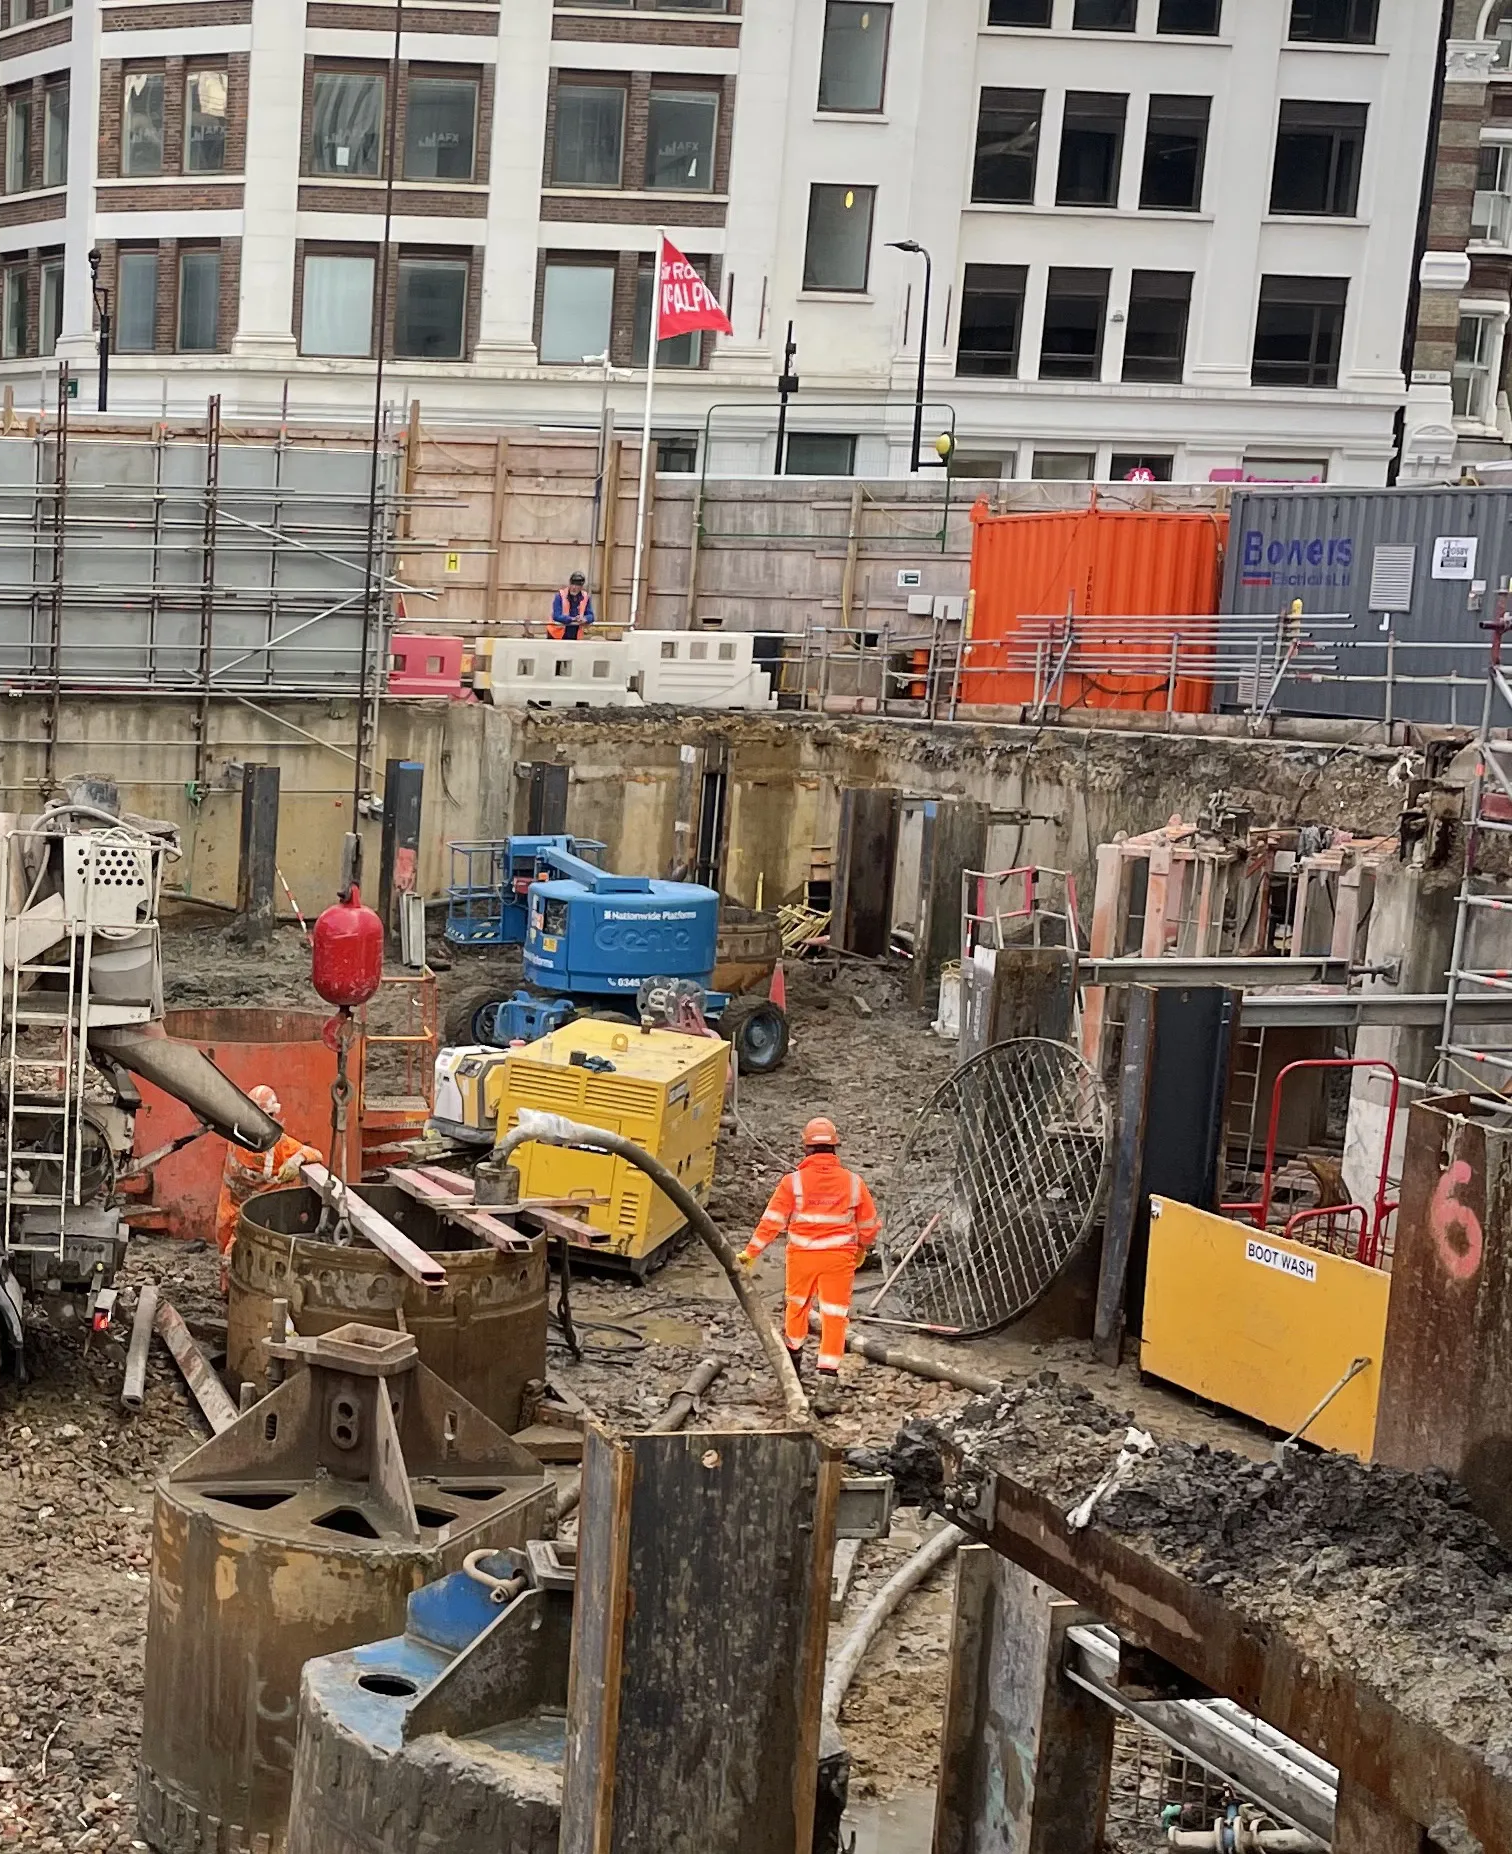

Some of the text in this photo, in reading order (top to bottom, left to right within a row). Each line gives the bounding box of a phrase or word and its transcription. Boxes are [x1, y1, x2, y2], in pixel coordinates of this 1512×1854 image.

[611, 911, 697, 920] Nationwide Platforms
[594, 920, 691, 952] Genie
[1430, 1160, 1483, 1280] 6
[1248, 1242, 1315, 1278] BOOT WASH
